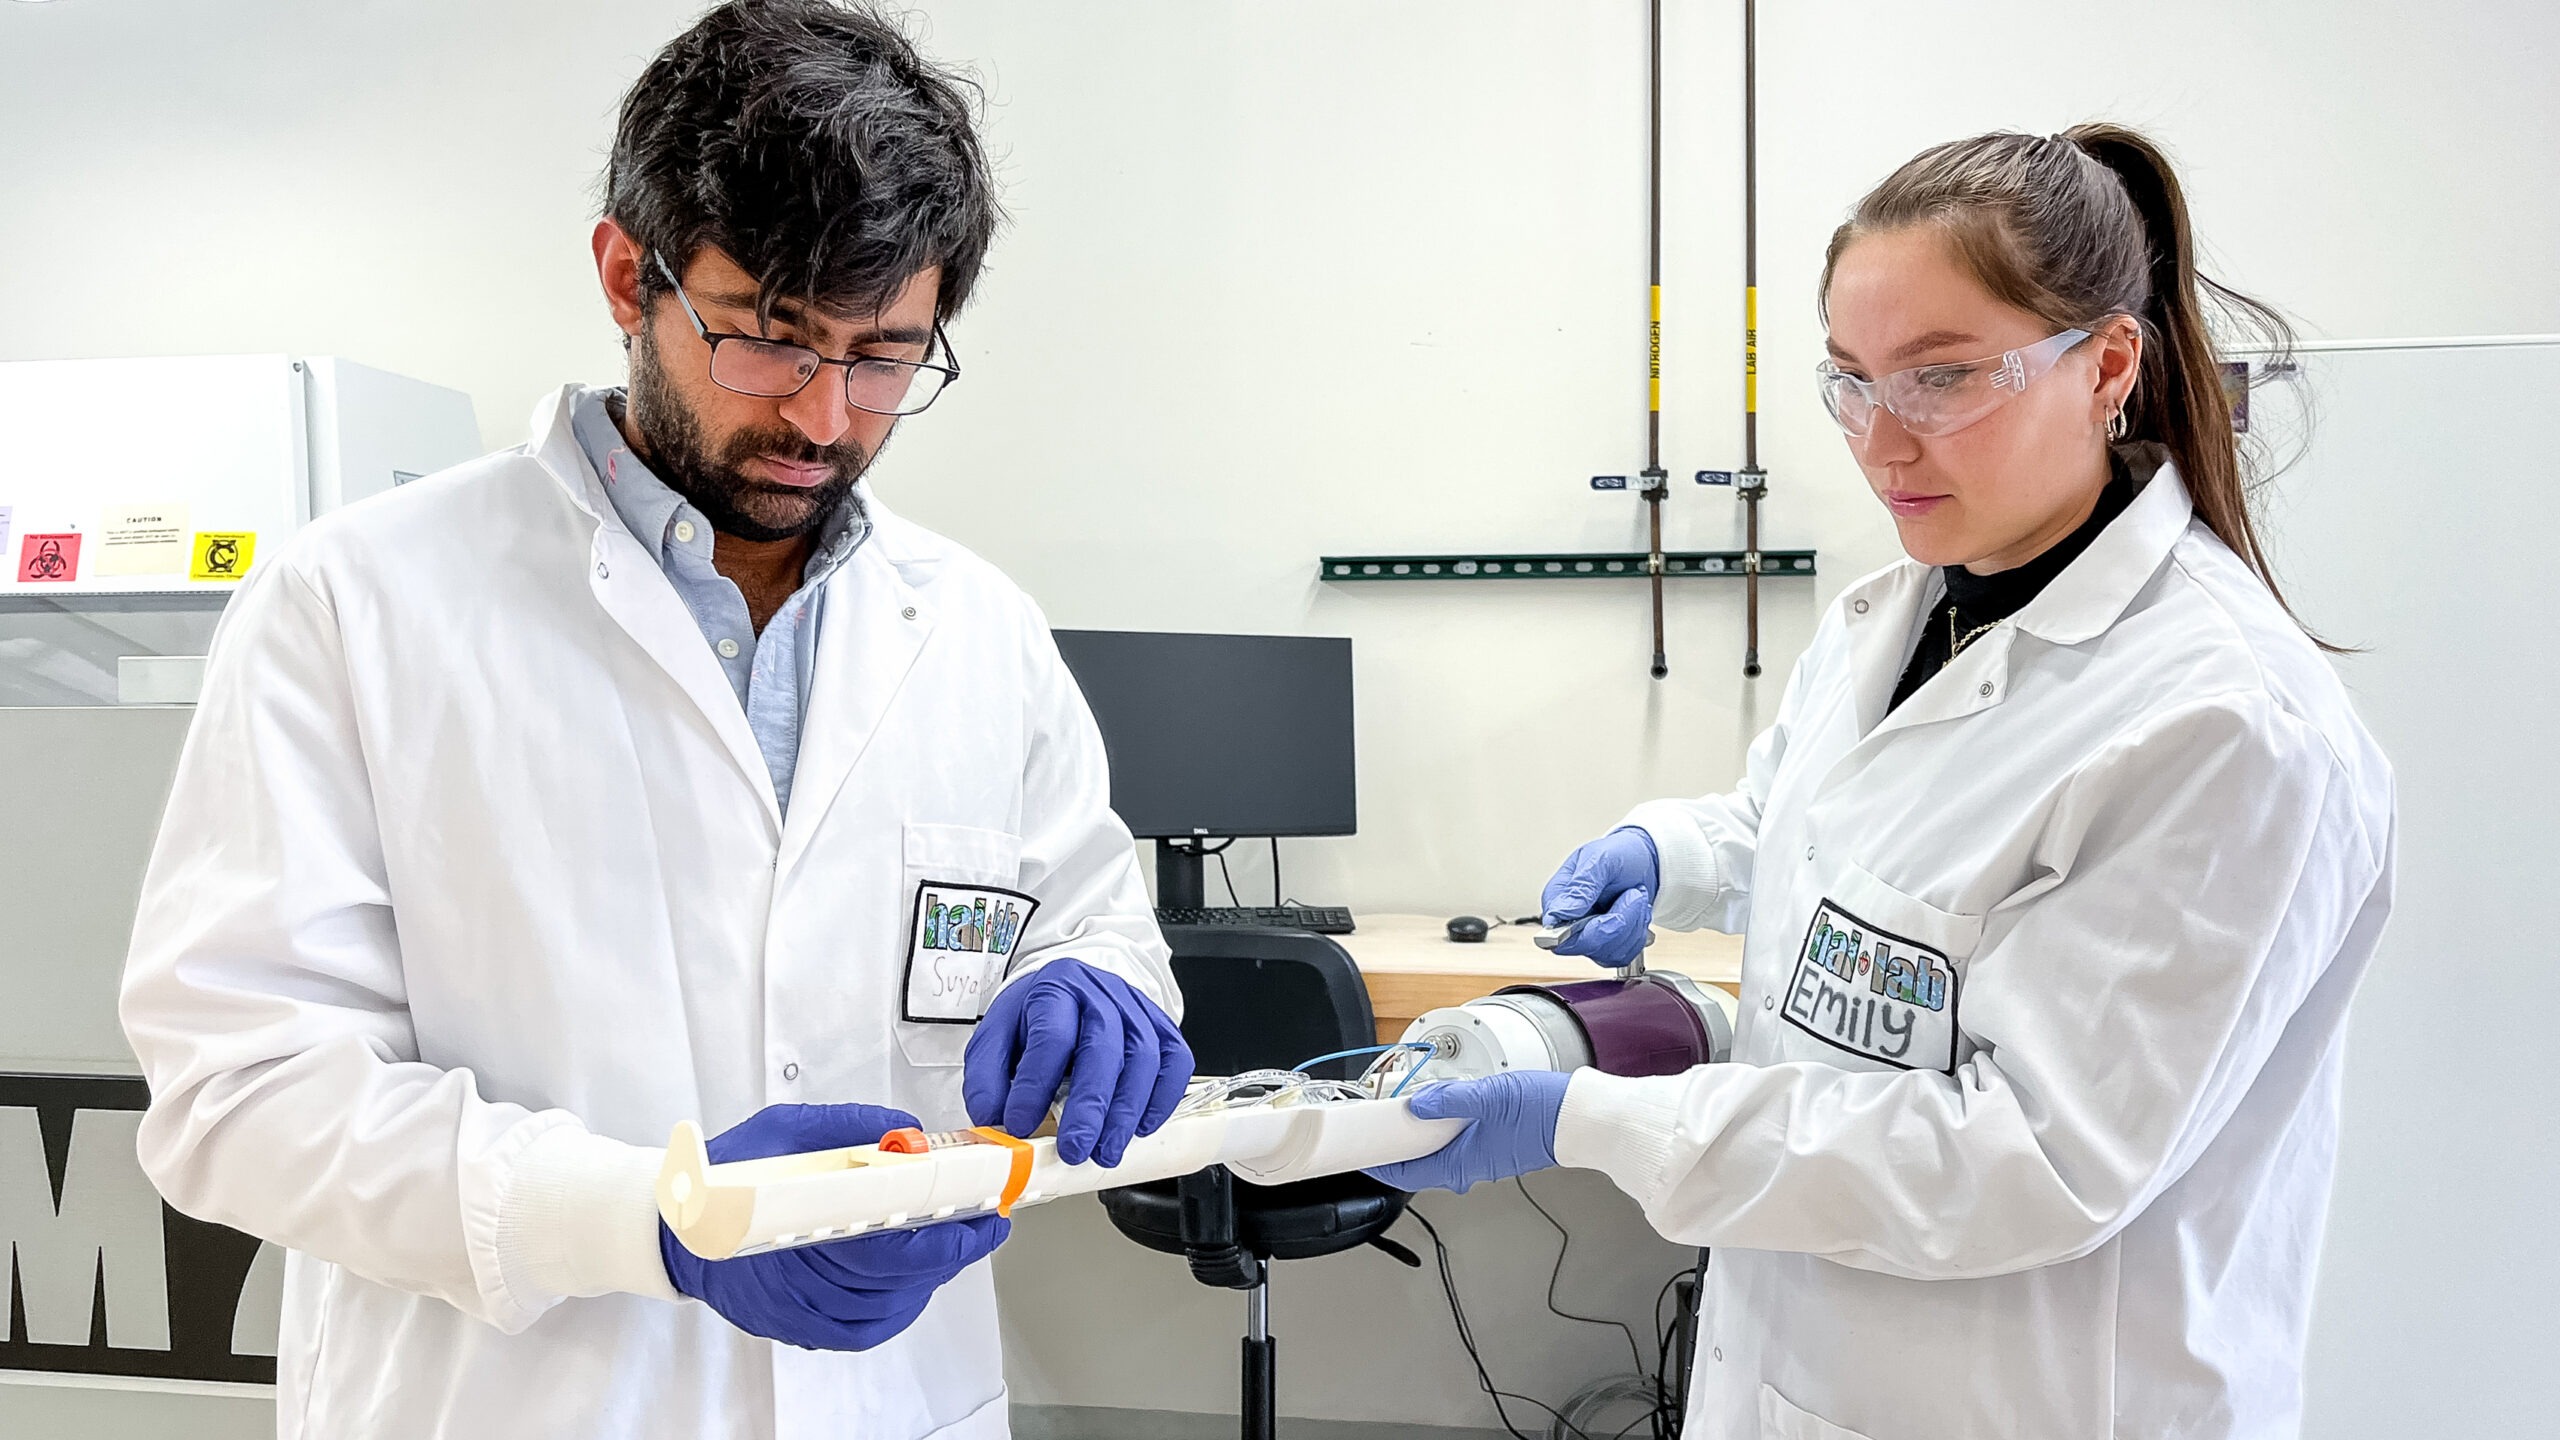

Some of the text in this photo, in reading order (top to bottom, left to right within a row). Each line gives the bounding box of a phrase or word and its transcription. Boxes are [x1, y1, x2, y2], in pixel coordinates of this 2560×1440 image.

[1650, 321, 1660, 379] NITROGEN
[1746, 329, 1757, 375] LAB AIR
[923, 893, 1019, 955] hai lb
[1808, 912, 1947, 1012] hai lab
[1791, 964, 1916, 1058] Emily
